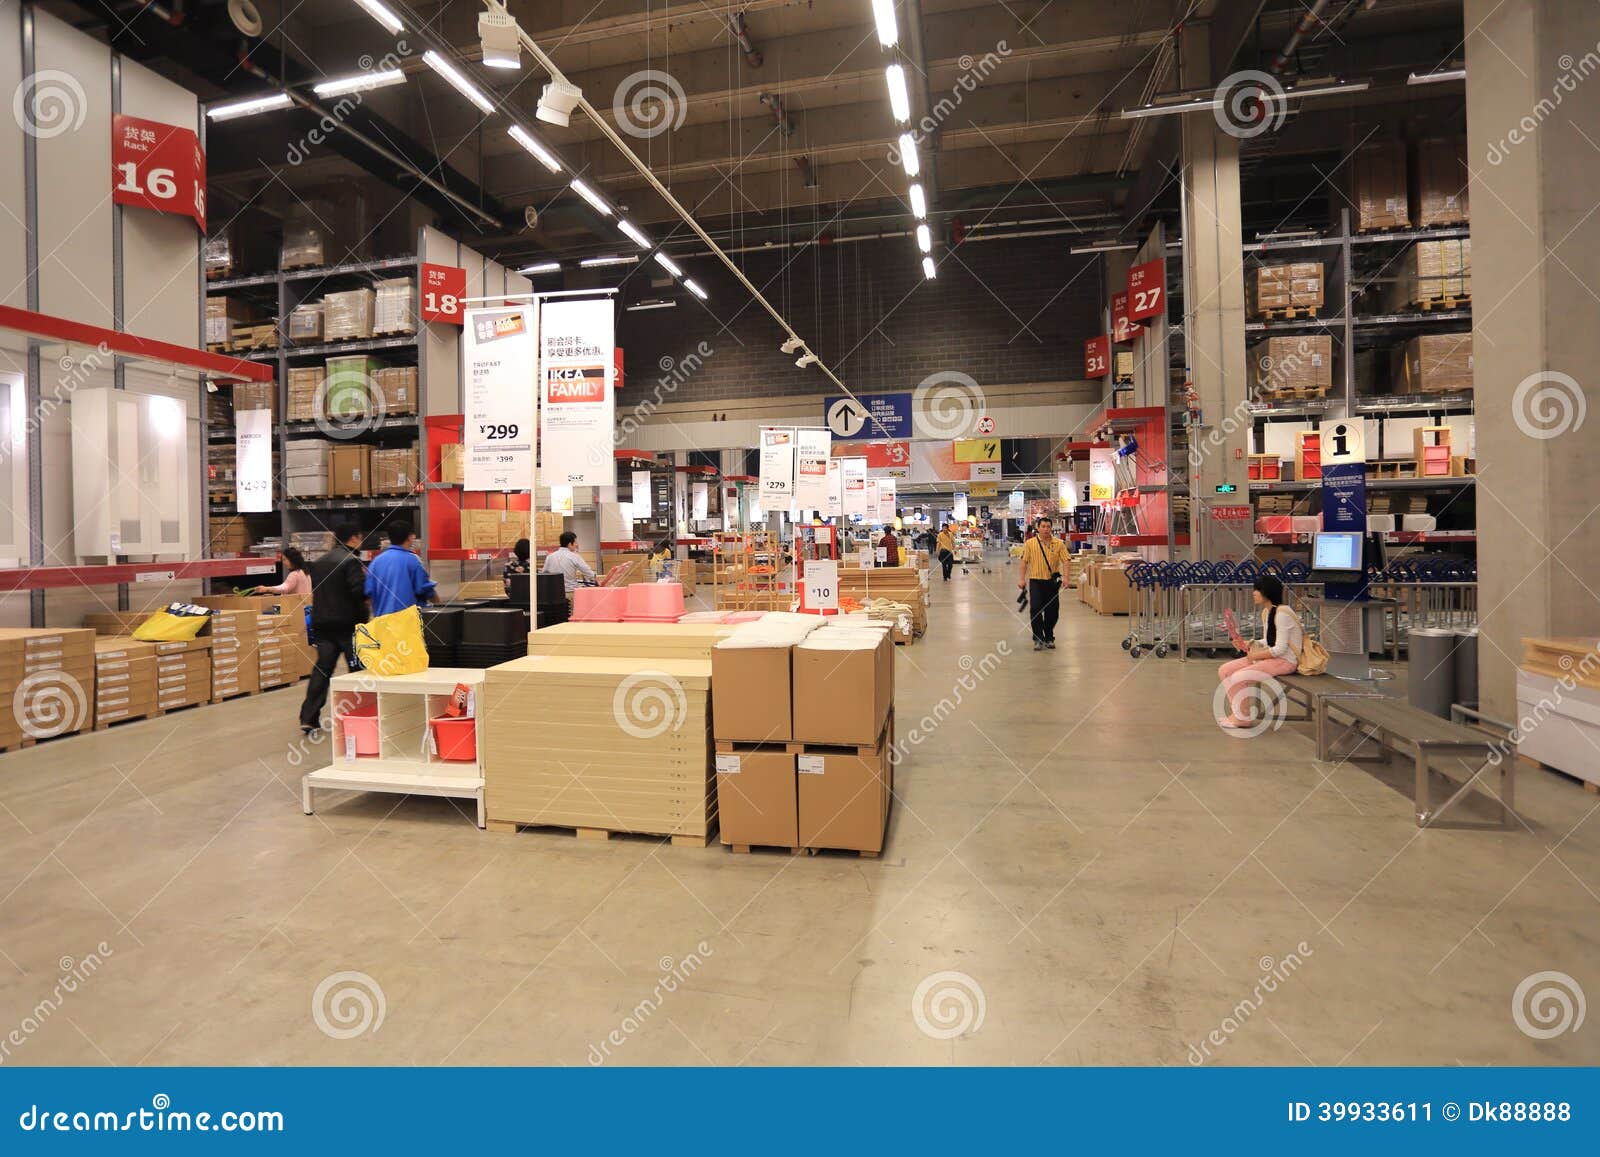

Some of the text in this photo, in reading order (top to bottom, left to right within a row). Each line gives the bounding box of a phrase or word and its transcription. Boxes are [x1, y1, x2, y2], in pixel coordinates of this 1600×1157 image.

[124, 126, 156, 143] 货架
[124, 140, 149, 152] Rack
[118, 161, 177, 199] 16
[425, 292, 458, 315] 18
[1135, 286, 1161, 313] 27
[1087, 355, 1105, 372] 31
[549, 369, 585, 381] IKEA
[549, 382, 600, 397] FAMILY
[480, 424, 519, 440] ¥299
